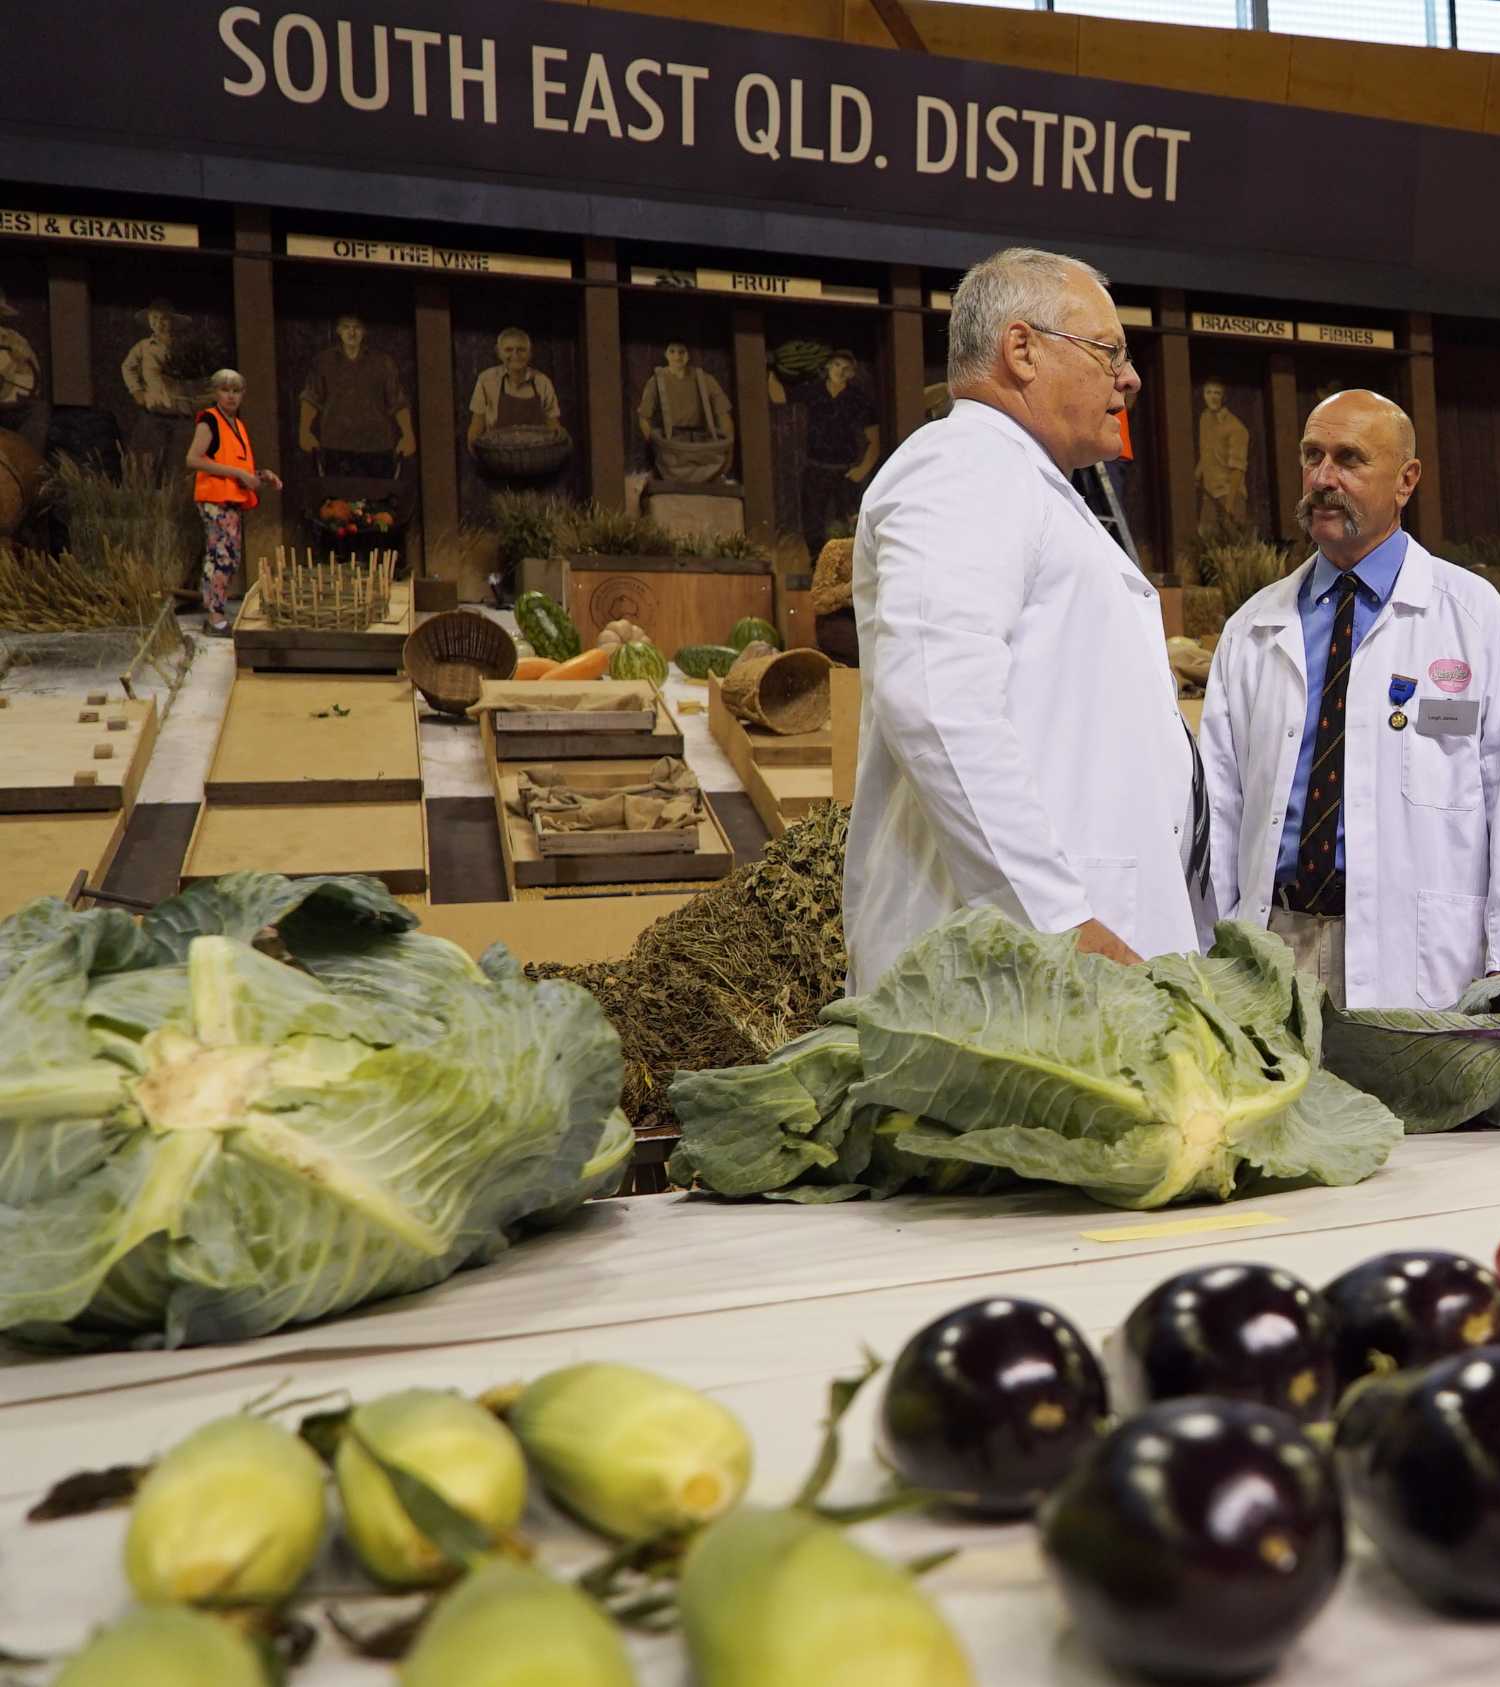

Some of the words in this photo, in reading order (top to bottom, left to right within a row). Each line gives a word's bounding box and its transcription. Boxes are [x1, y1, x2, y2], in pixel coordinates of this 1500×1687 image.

[218, 6, 497, 125] SOUTH
[532, 45, 709, 147] EAST
[734, 72, 888, 170] QLD.
[916, 94, 1191, 203] DISTRICT
[44, 217, 61, 235] &
[69, 217, 166, 242] GRAINS
[333, 239, 378, 259] OFF
[386, 244, 430, 264] THE
[439, 251, 489, 272] VINE
[731, 273, 790, 294] FRUIT
[1200, 315, 1286, 337] BRASSICAS
[1319, 326, 1374, 345] FIBRES
